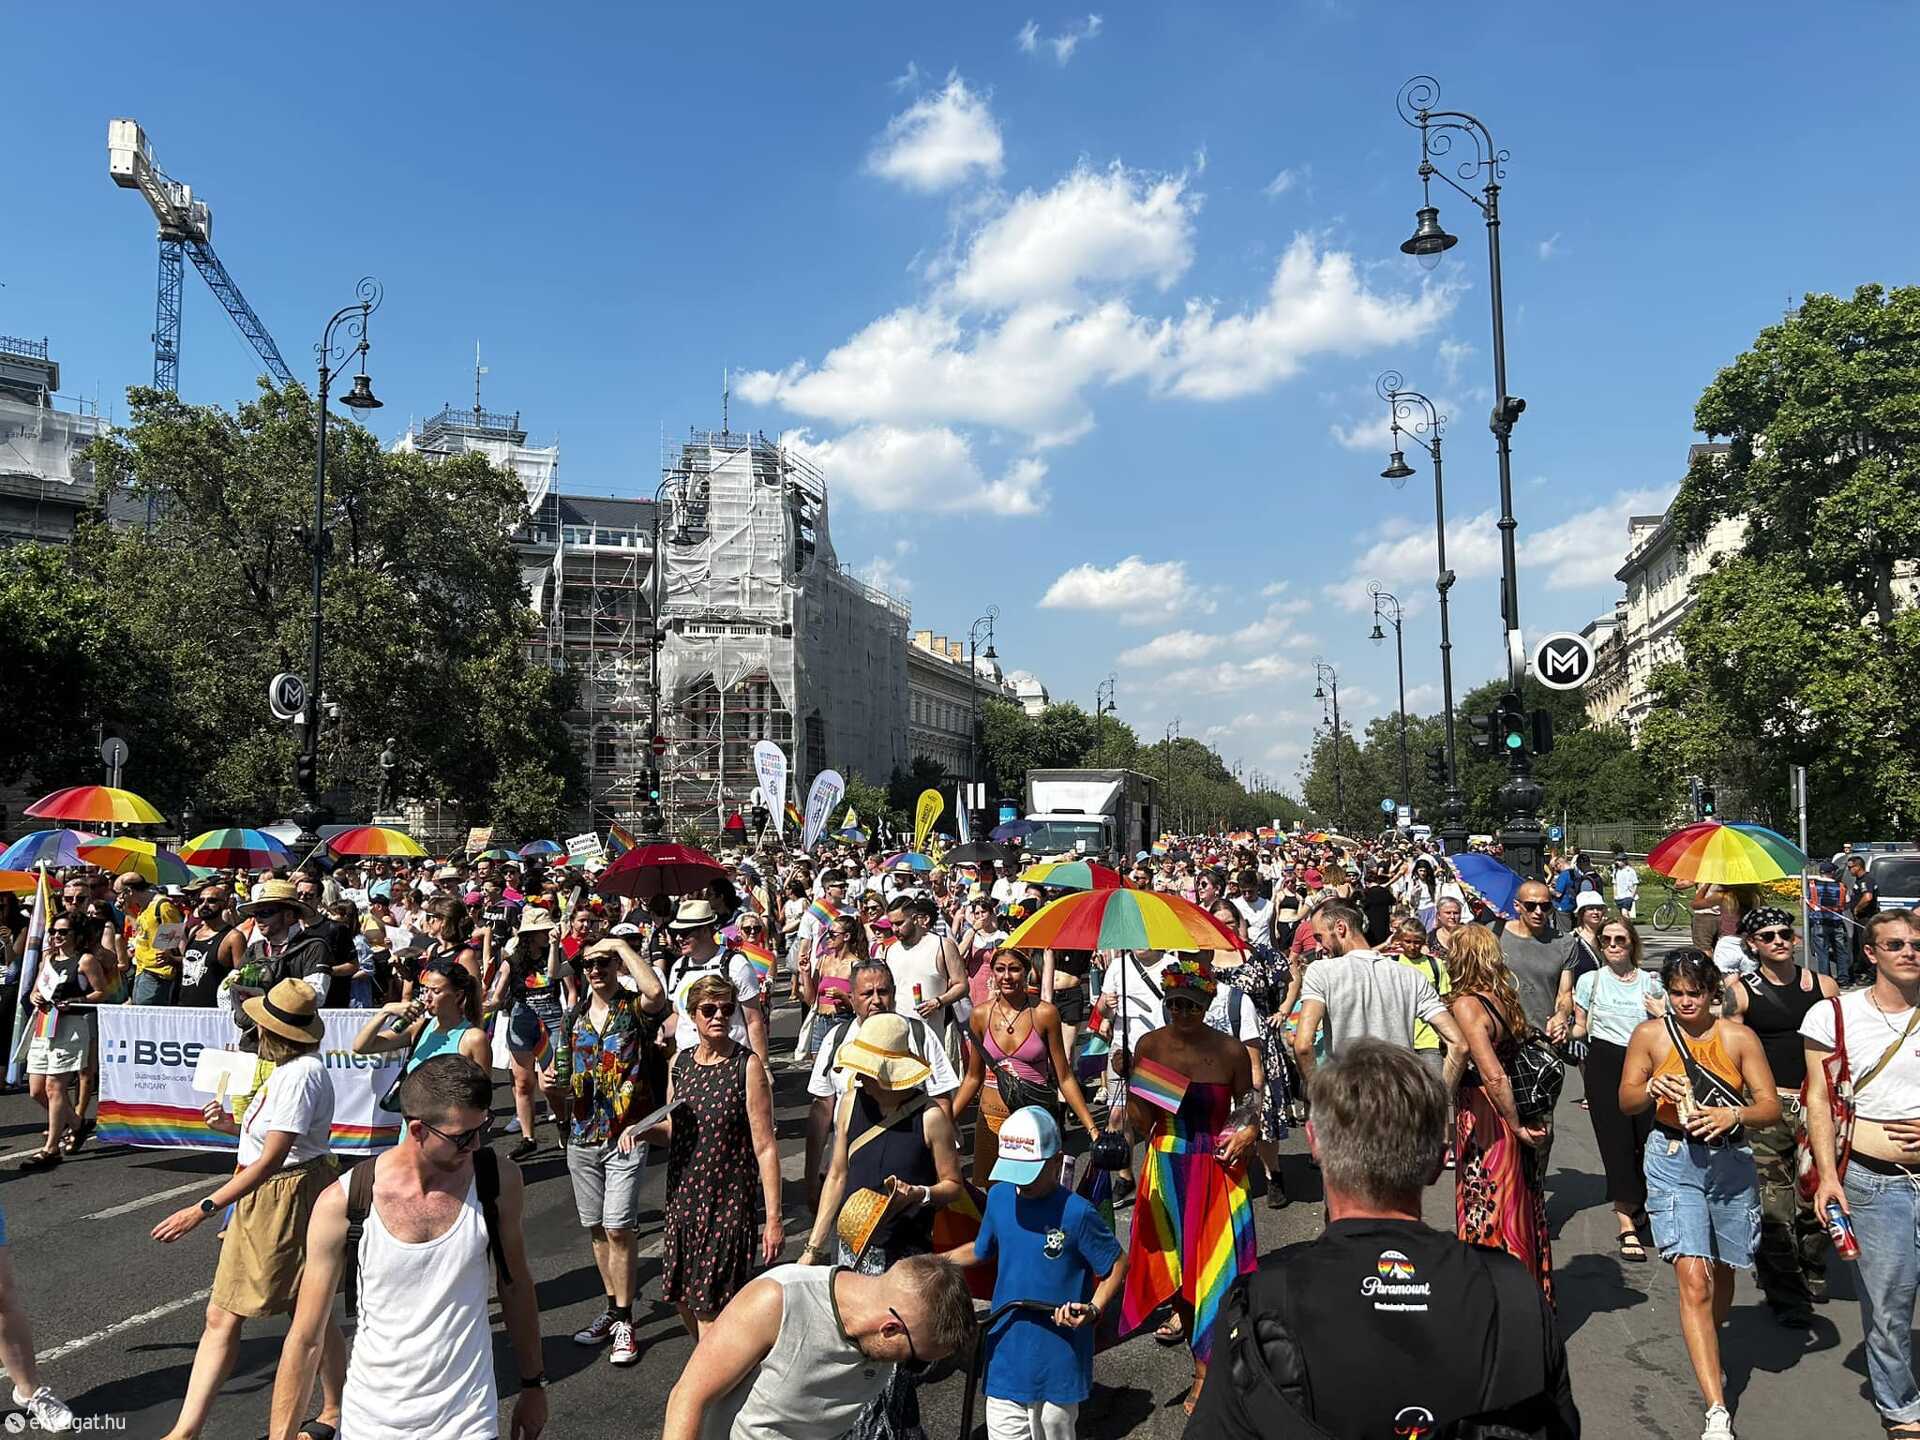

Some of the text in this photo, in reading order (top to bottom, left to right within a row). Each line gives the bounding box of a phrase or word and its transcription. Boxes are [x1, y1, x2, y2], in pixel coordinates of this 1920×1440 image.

[1547, 645, 1579, 675] M
[284, 682, 301, 705] M
[134, 1040, 205, 1068] BSS
[1361, 1276, 1431, 1296] Paramount
